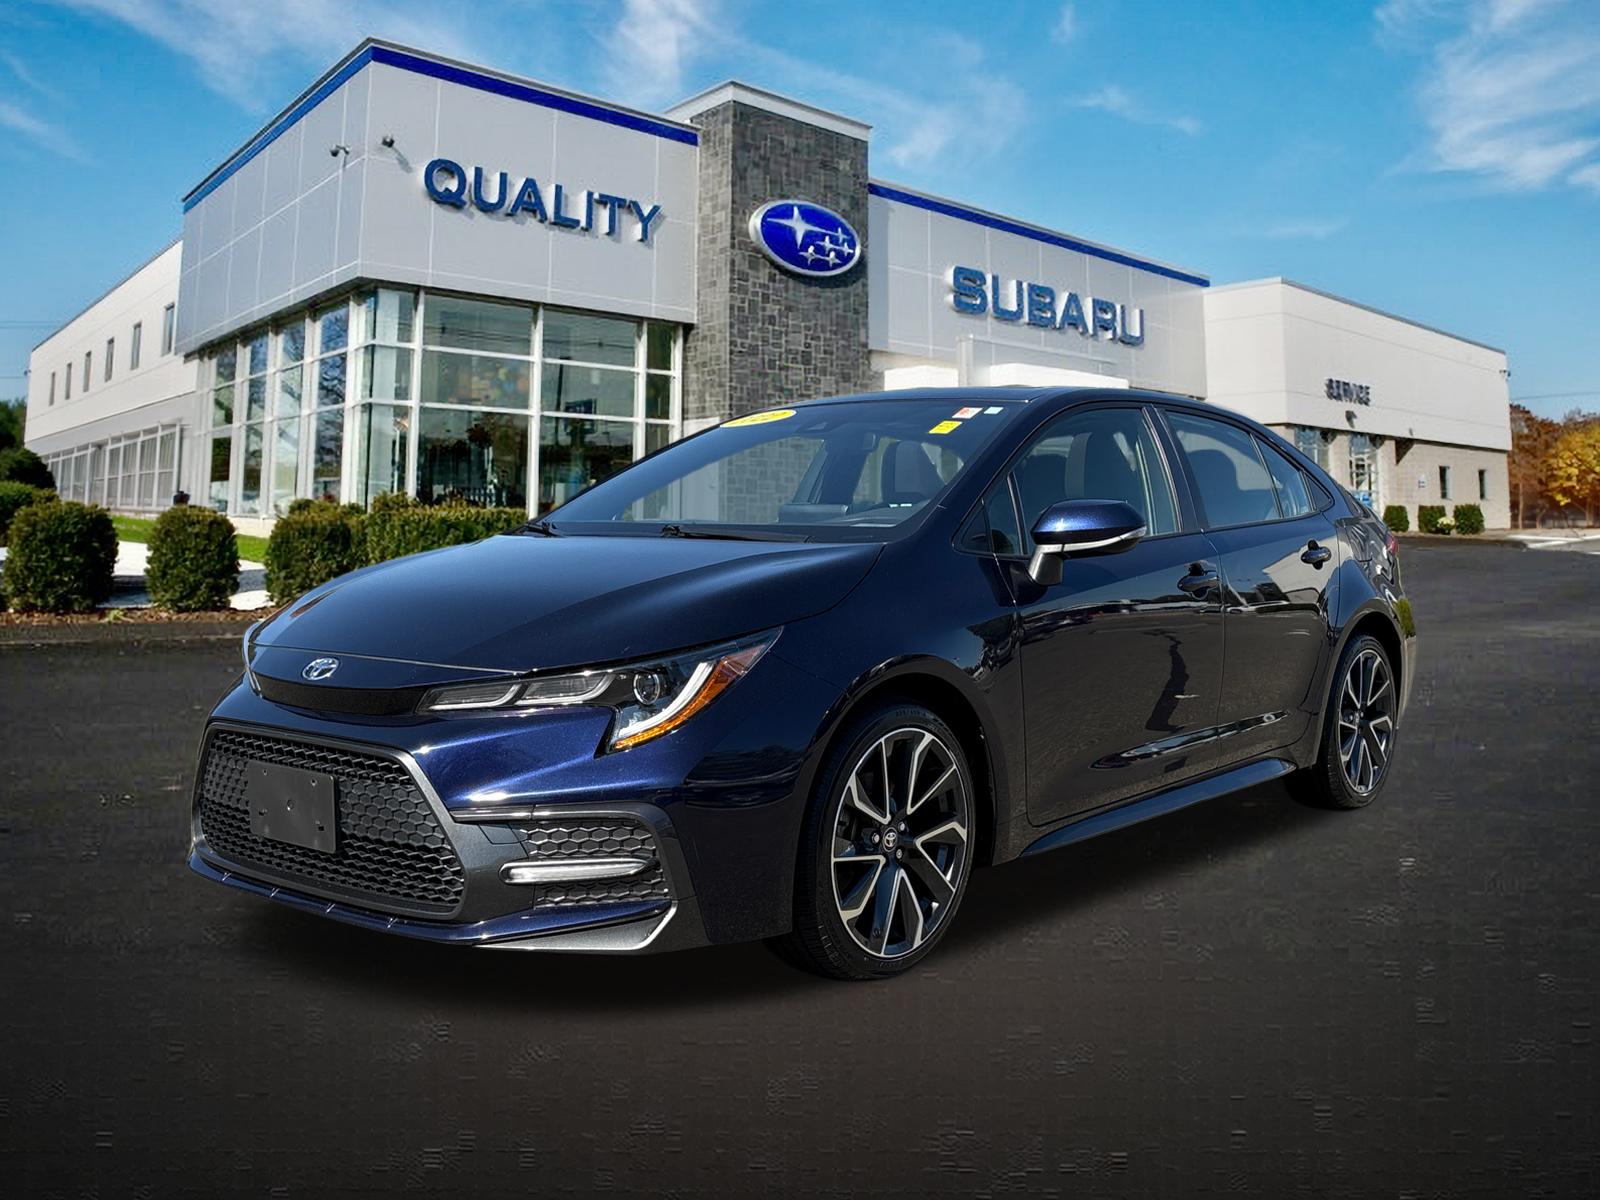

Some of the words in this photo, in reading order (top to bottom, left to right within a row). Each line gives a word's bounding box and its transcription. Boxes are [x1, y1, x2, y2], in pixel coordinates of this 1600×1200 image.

[424, 157, 662, 243] QUALITY
[950, 265, 1145, 346] SUBARU
[1325, 378, 1371, 407] SERVICE
